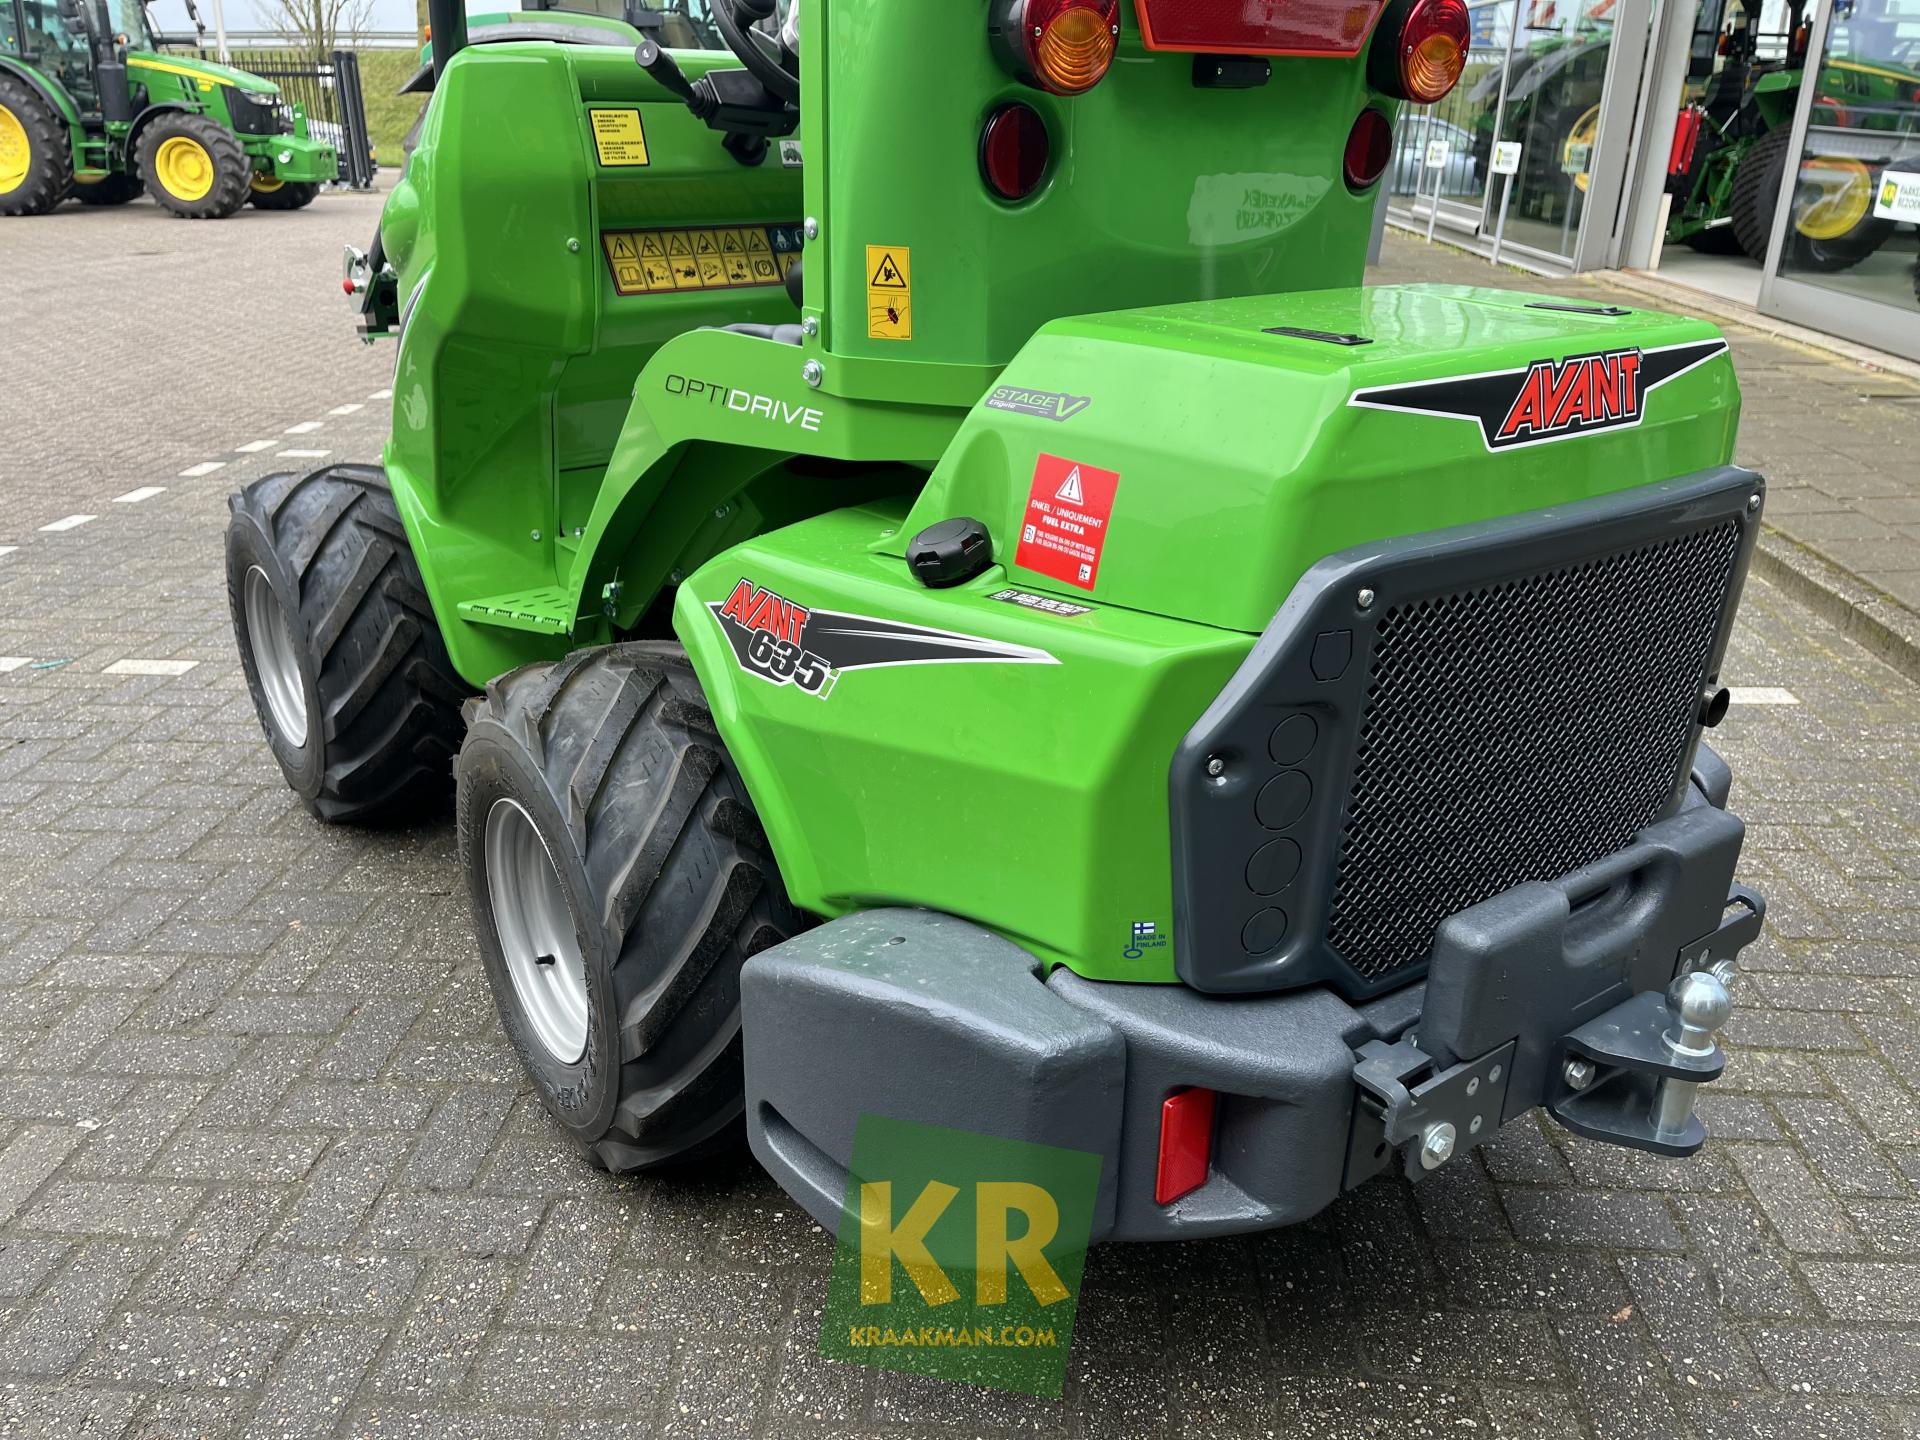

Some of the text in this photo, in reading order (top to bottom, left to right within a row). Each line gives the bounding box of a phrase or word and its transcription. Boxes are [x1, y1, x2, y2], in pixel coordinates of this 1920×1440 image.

[665, 374, 824, 432] OPTIDRIVE
[993, 388, 1086, 417] STAGE V
[1494, 350, 1642, 441] AVANT
[1031, 499, 1050, 513] ENKEL
[1057, 506, 1103, 528] UNIQUEMENT
[1042, 515, 1085, 536] FUEL EXTRA
[719, 577, 812, 648] AVANT
